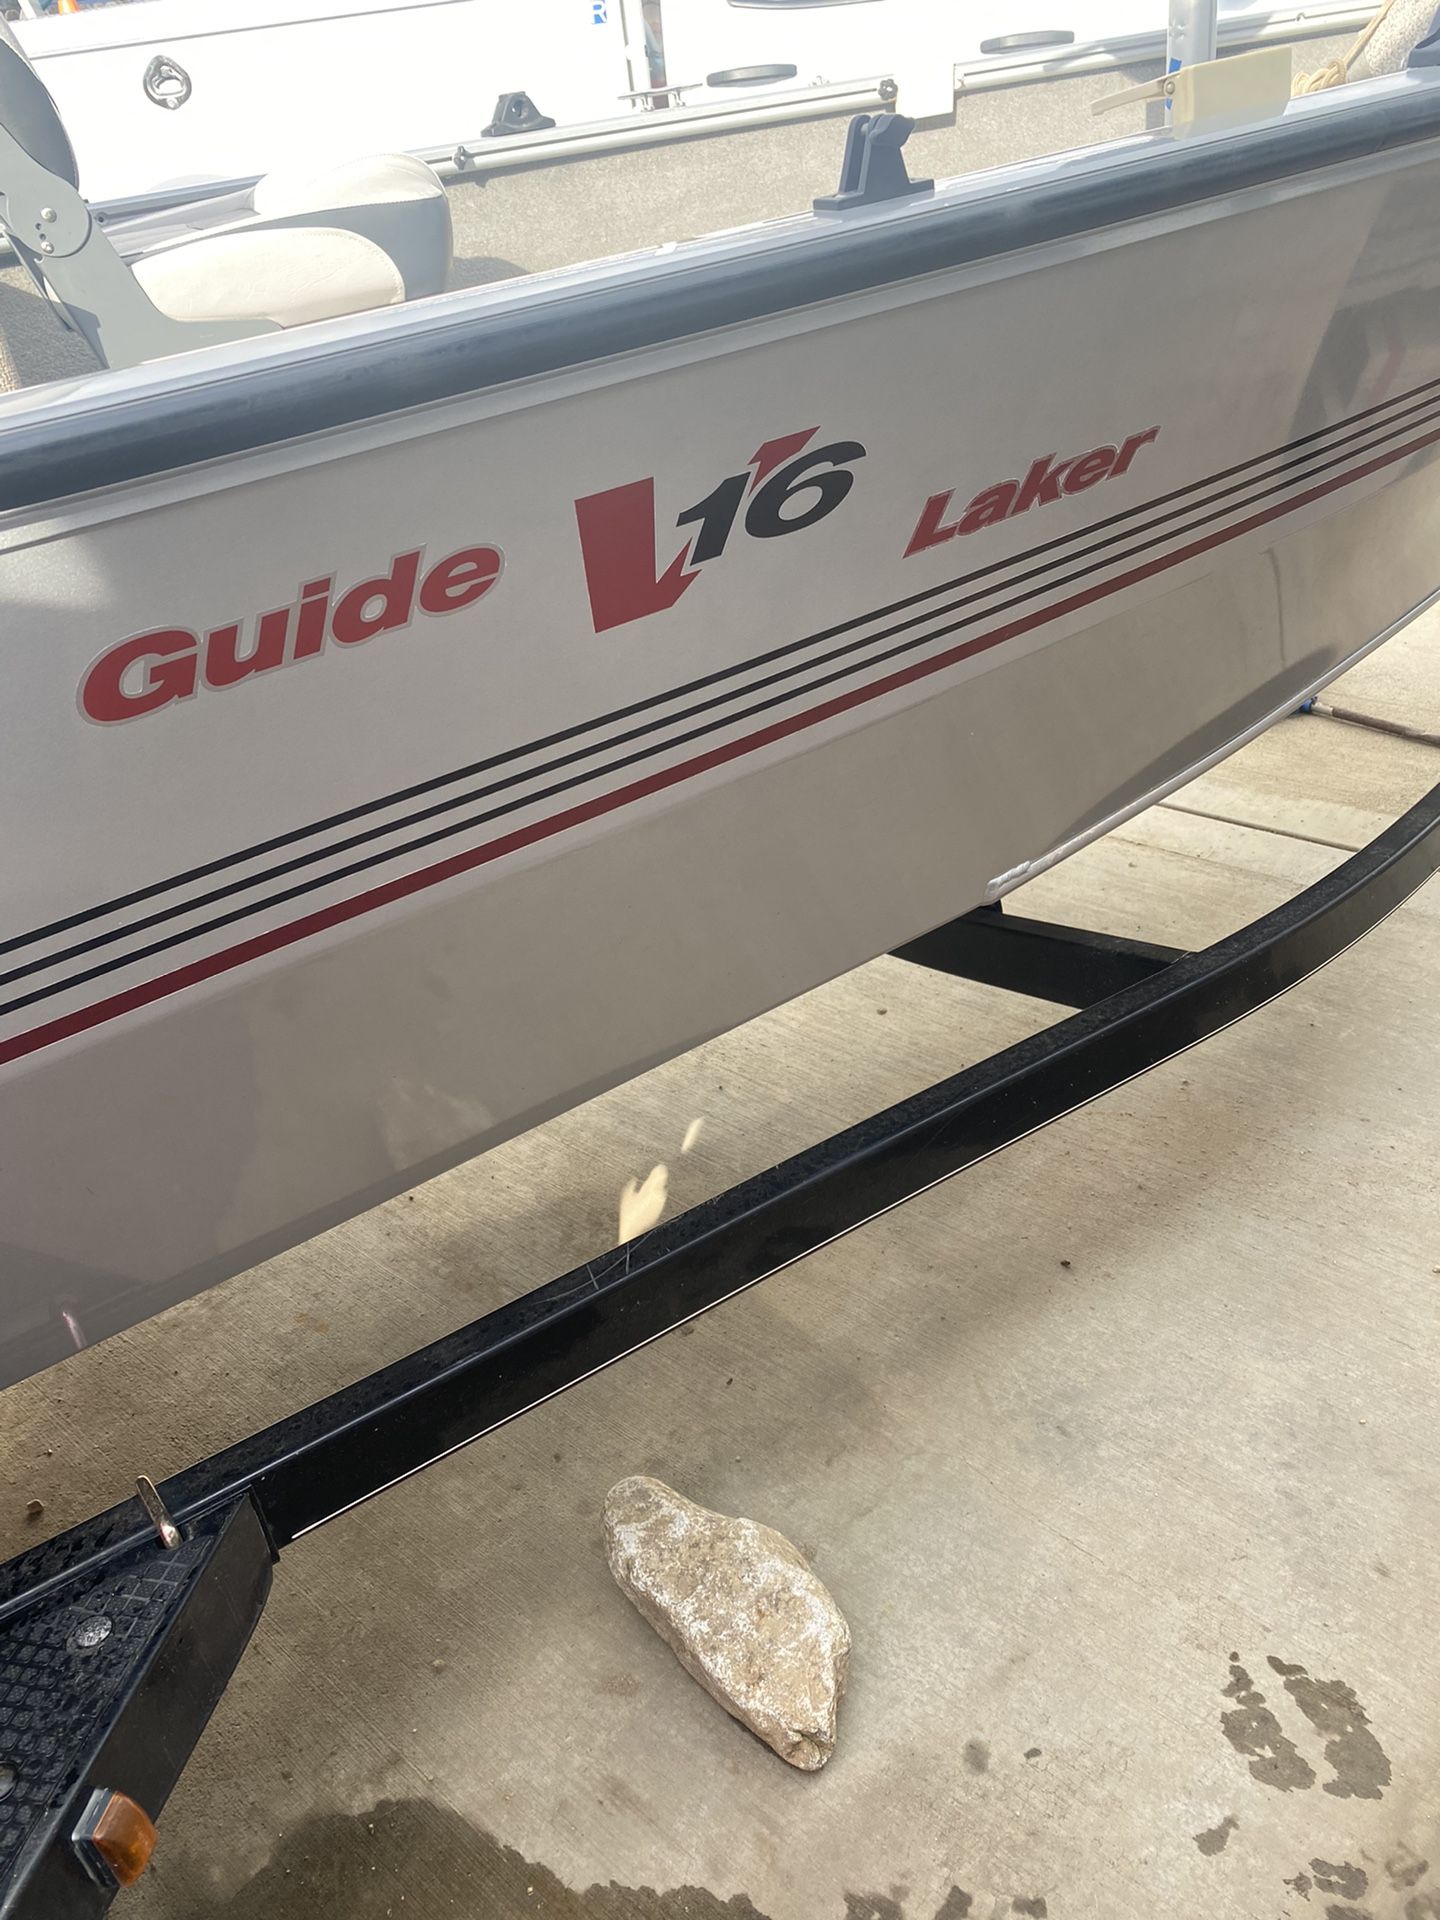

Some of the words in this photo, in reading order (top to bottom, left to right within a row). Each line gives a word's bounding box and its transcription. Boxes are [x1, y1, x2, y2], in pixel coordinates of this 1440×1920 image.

[77, 543, 504, 726] Guide
[574, 425, 867, 633] V16
[902, 425, 1161, 559] Laker
